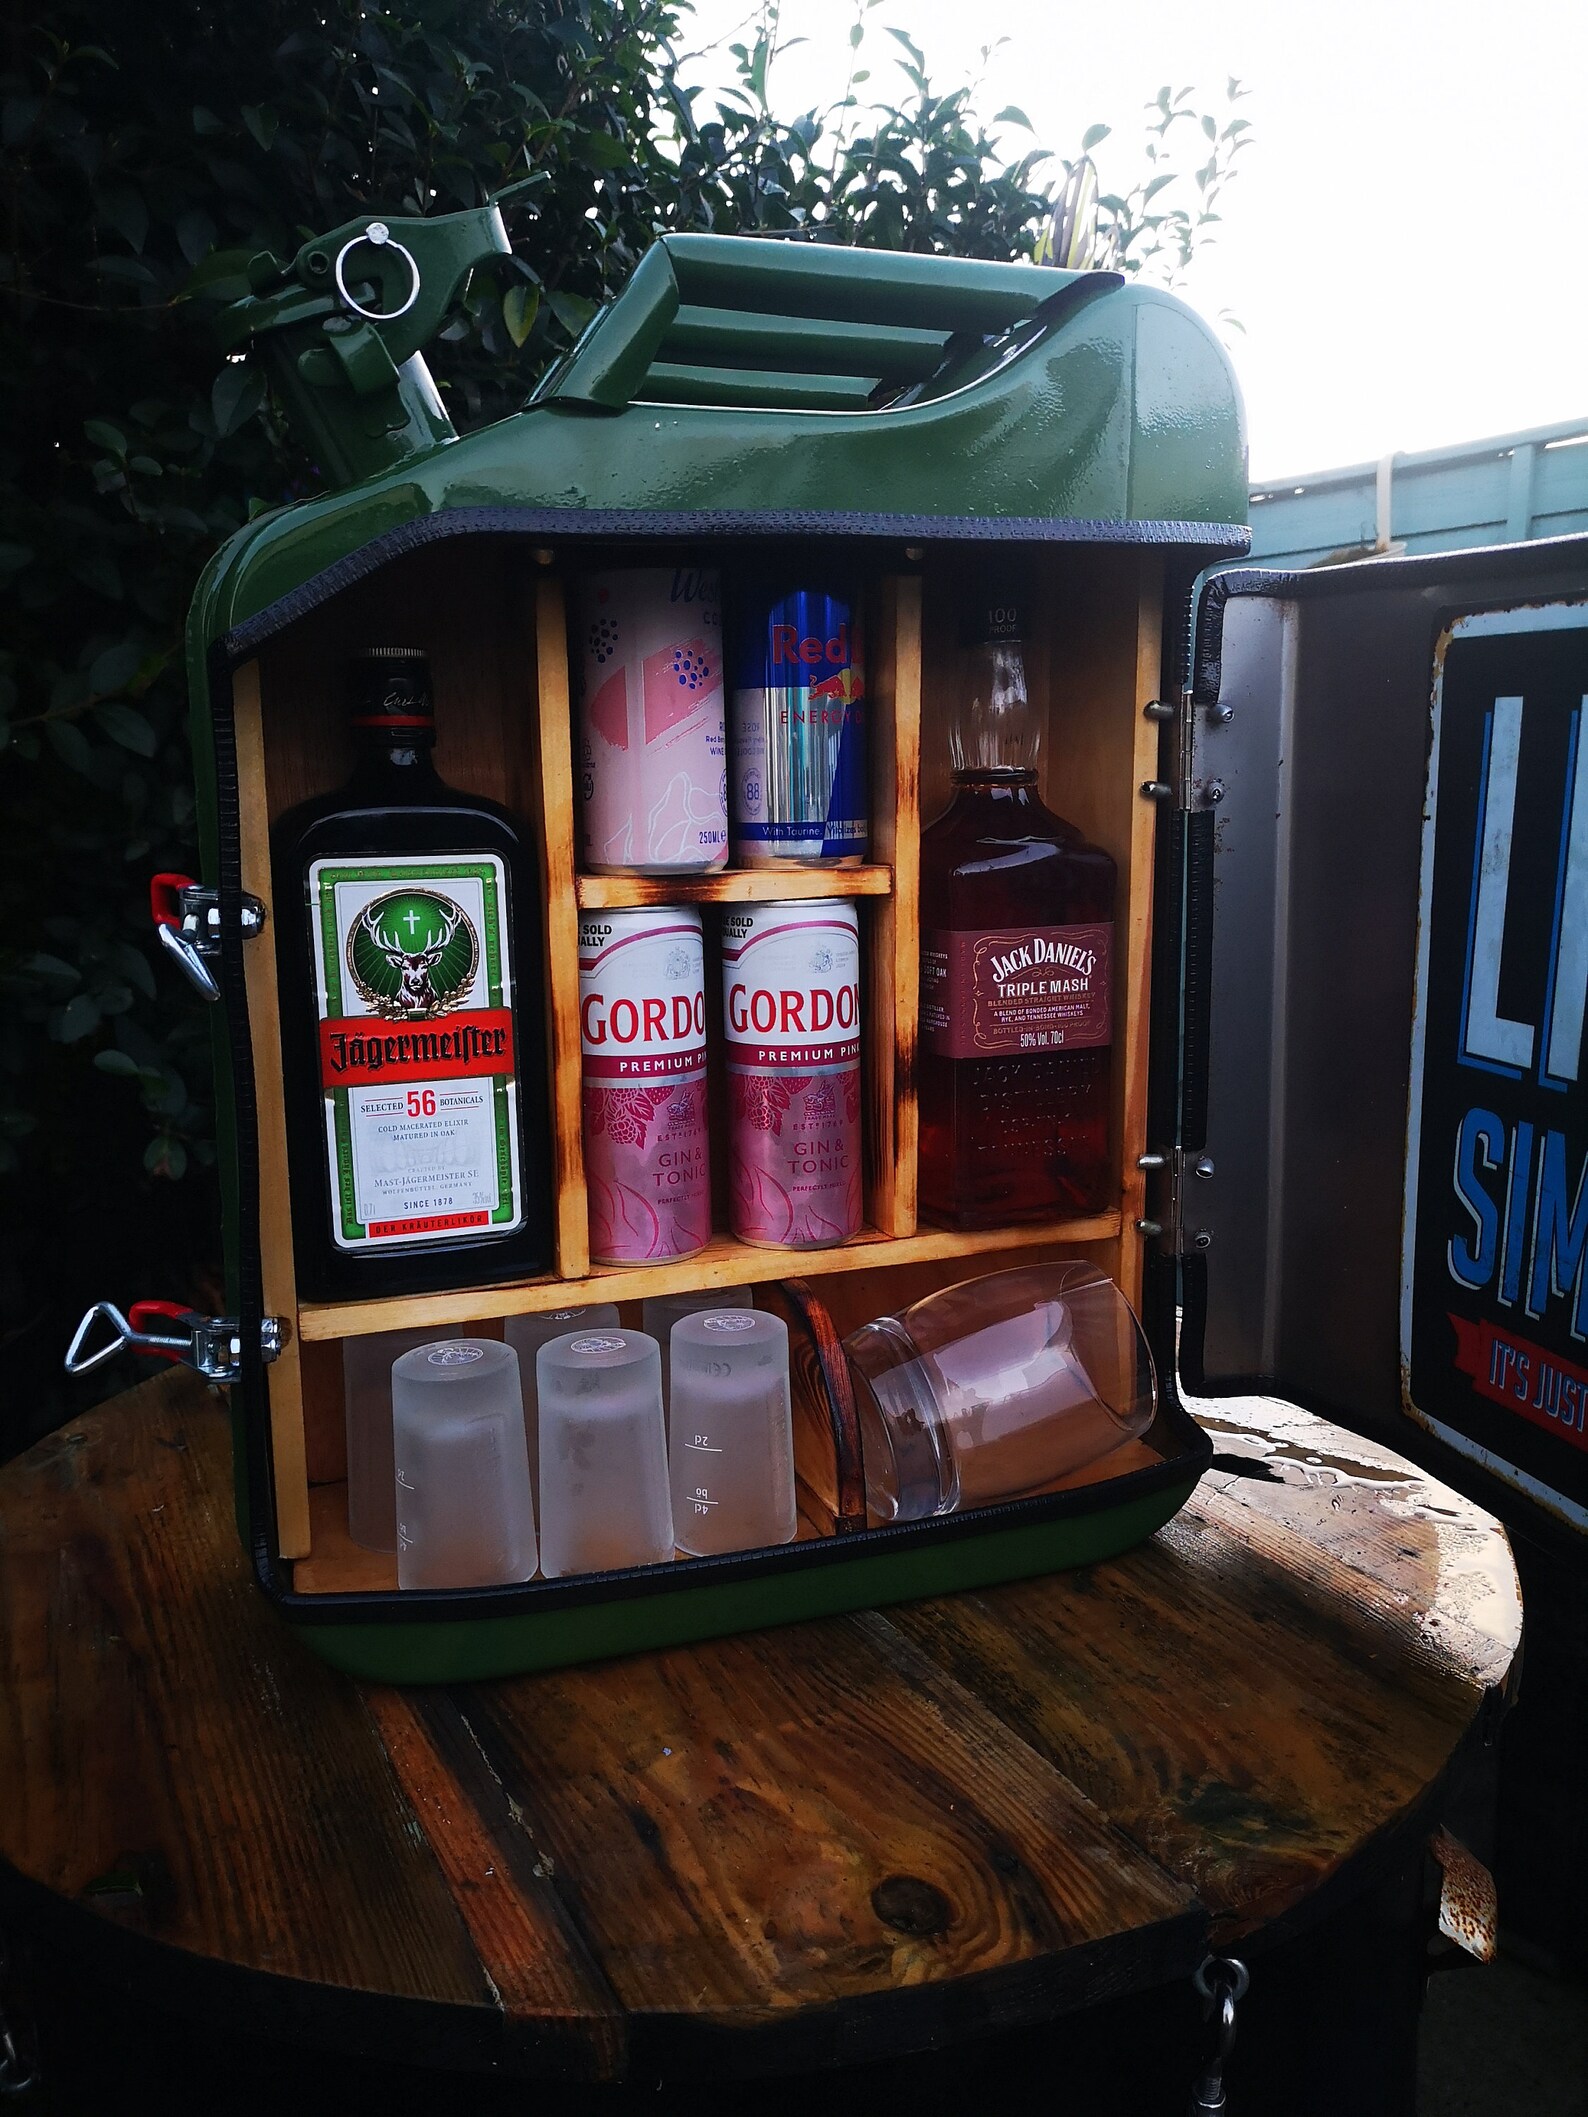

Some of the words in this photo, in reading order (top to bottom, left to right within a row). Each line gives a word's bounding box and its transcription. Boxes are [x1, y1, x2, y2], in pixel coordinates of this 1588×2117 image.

[989, 608, 1017, 623] 100
[772, 622, 847, 665] Red
[781, 710, 850, 724] ENERGY
[699, 831, 720, 844] 250ML
[762, 826, 784, 836] With
[786, 826, 823, 836] Taurine.
[583, 924, 612, 935] SOLD
[731, 917, 753, 927] SOLD
[579, 936, 605, 947] ALLY
[990, 944, 1034, 983] JACK
[1033, 937, 1097, 976] DANIEL'S
[998, 981, 1047, 998] TRIPLE
[1050, 977, 1088, 994] MASH
[987, 998, 1023, 1007] BLENDED
[1024, 995, 1061, 1005] STRAIGHT
[1063, 992, 1096, 1001] WHISKEY
[1025, 1007, 1047, 1015] BONDED
[1047, 1004, 1075, 1013] AMERICAN
[1026, 1013, 1057, 1021] TENNESSEE
[581, 991, 705, 1045] GORDO
[1020, 1031, 1037, 1047] 50%
[1050, 1030, 1065, 1045] 70cl
[330, 1024, 507, 1073] Jägermeister
[759, 1048, 834, 1062] PREMIUM
[619, 1055, 693, 1073] PREMIUM
[360, 1101, 404, 1113] SELECTED
[407, 1089, 436, 1117] 56
[439, 1095, 484, 1107] BOTANICALS
[378, 1124, 398, 1133] COLD
[399, 1121, 443, 1131] MACERATED
[444, 1118, 469, 1127] ELIXIR
[393, 1132, 428, 1141] MATURED
[440, 1129, 456, 1137] OAK
[794, 1140, 830, 1156] GIN
[834, 1138, 844, 1151] &
[659, 1149, 691, 1167] GIN
[694, 1146, 702, 1160] &
[787, 1155, 849, 1174] TONIC
[467, 1169, 479, 1178] SE
[652, 1163, 706, 1187] TONIC
[792, 1183, 828, 1192] PERFECTLY
[403, 1200, 430, 1210] SINCE
[433, 1197, 453, 1206] 1878
[375, 1223, 396, 1234] DER
[402, 1214, 482, 1231] KRÄUTERLIKÖR
[1447, 1106, 1588, 1343] SIM
[1489, 1337, 1530, 1401] IT'S
[1533, 1359, 1588, 1432] JUST
